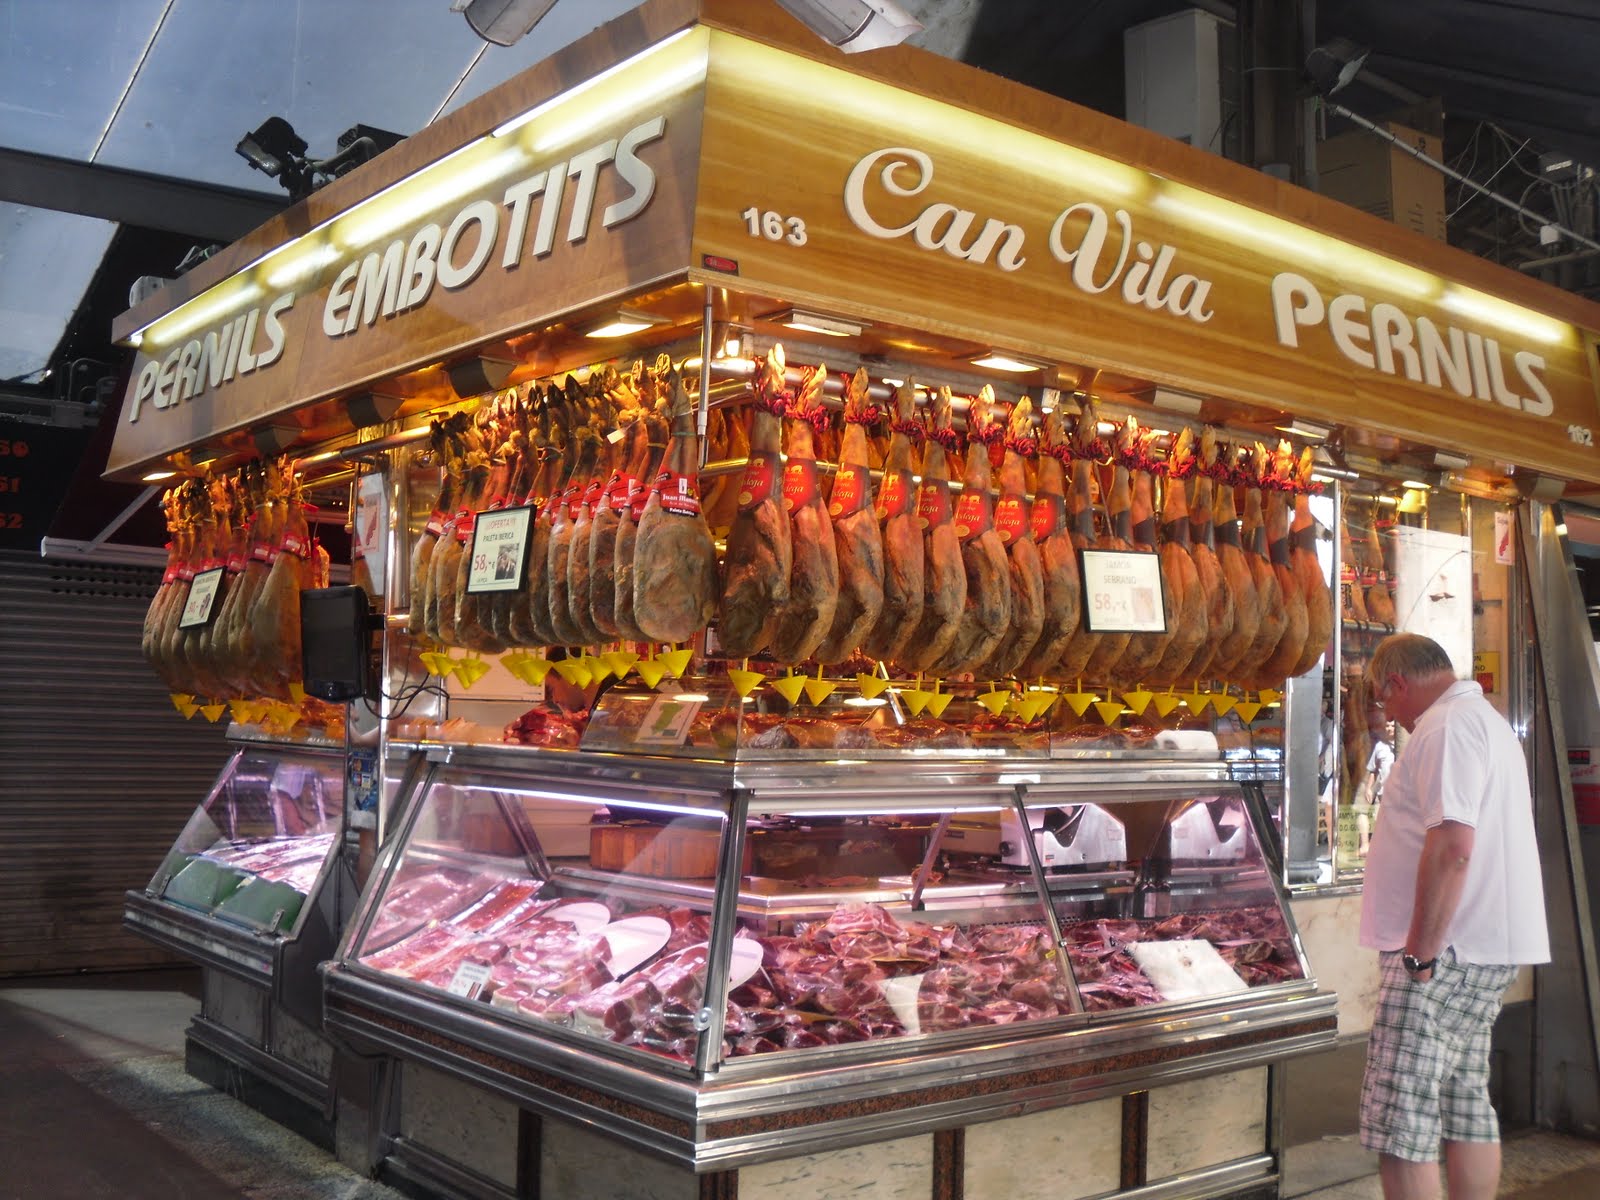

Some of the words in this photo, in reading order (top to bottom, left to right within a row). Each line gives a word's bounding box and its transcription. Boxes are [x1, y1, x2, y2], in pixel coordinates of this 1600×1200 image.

[129, 292, 295, 423] PERNILS
[322, 115, 666, 337] EMBOTITS
[743, 207, 807, 247] 163
[844, 146, 1026, 272] Can
[1049, 202, 1214, 322] Vila
[1271, 271, 1554, 417] PERNILS
[1567, 424, 1593, 446] 162
